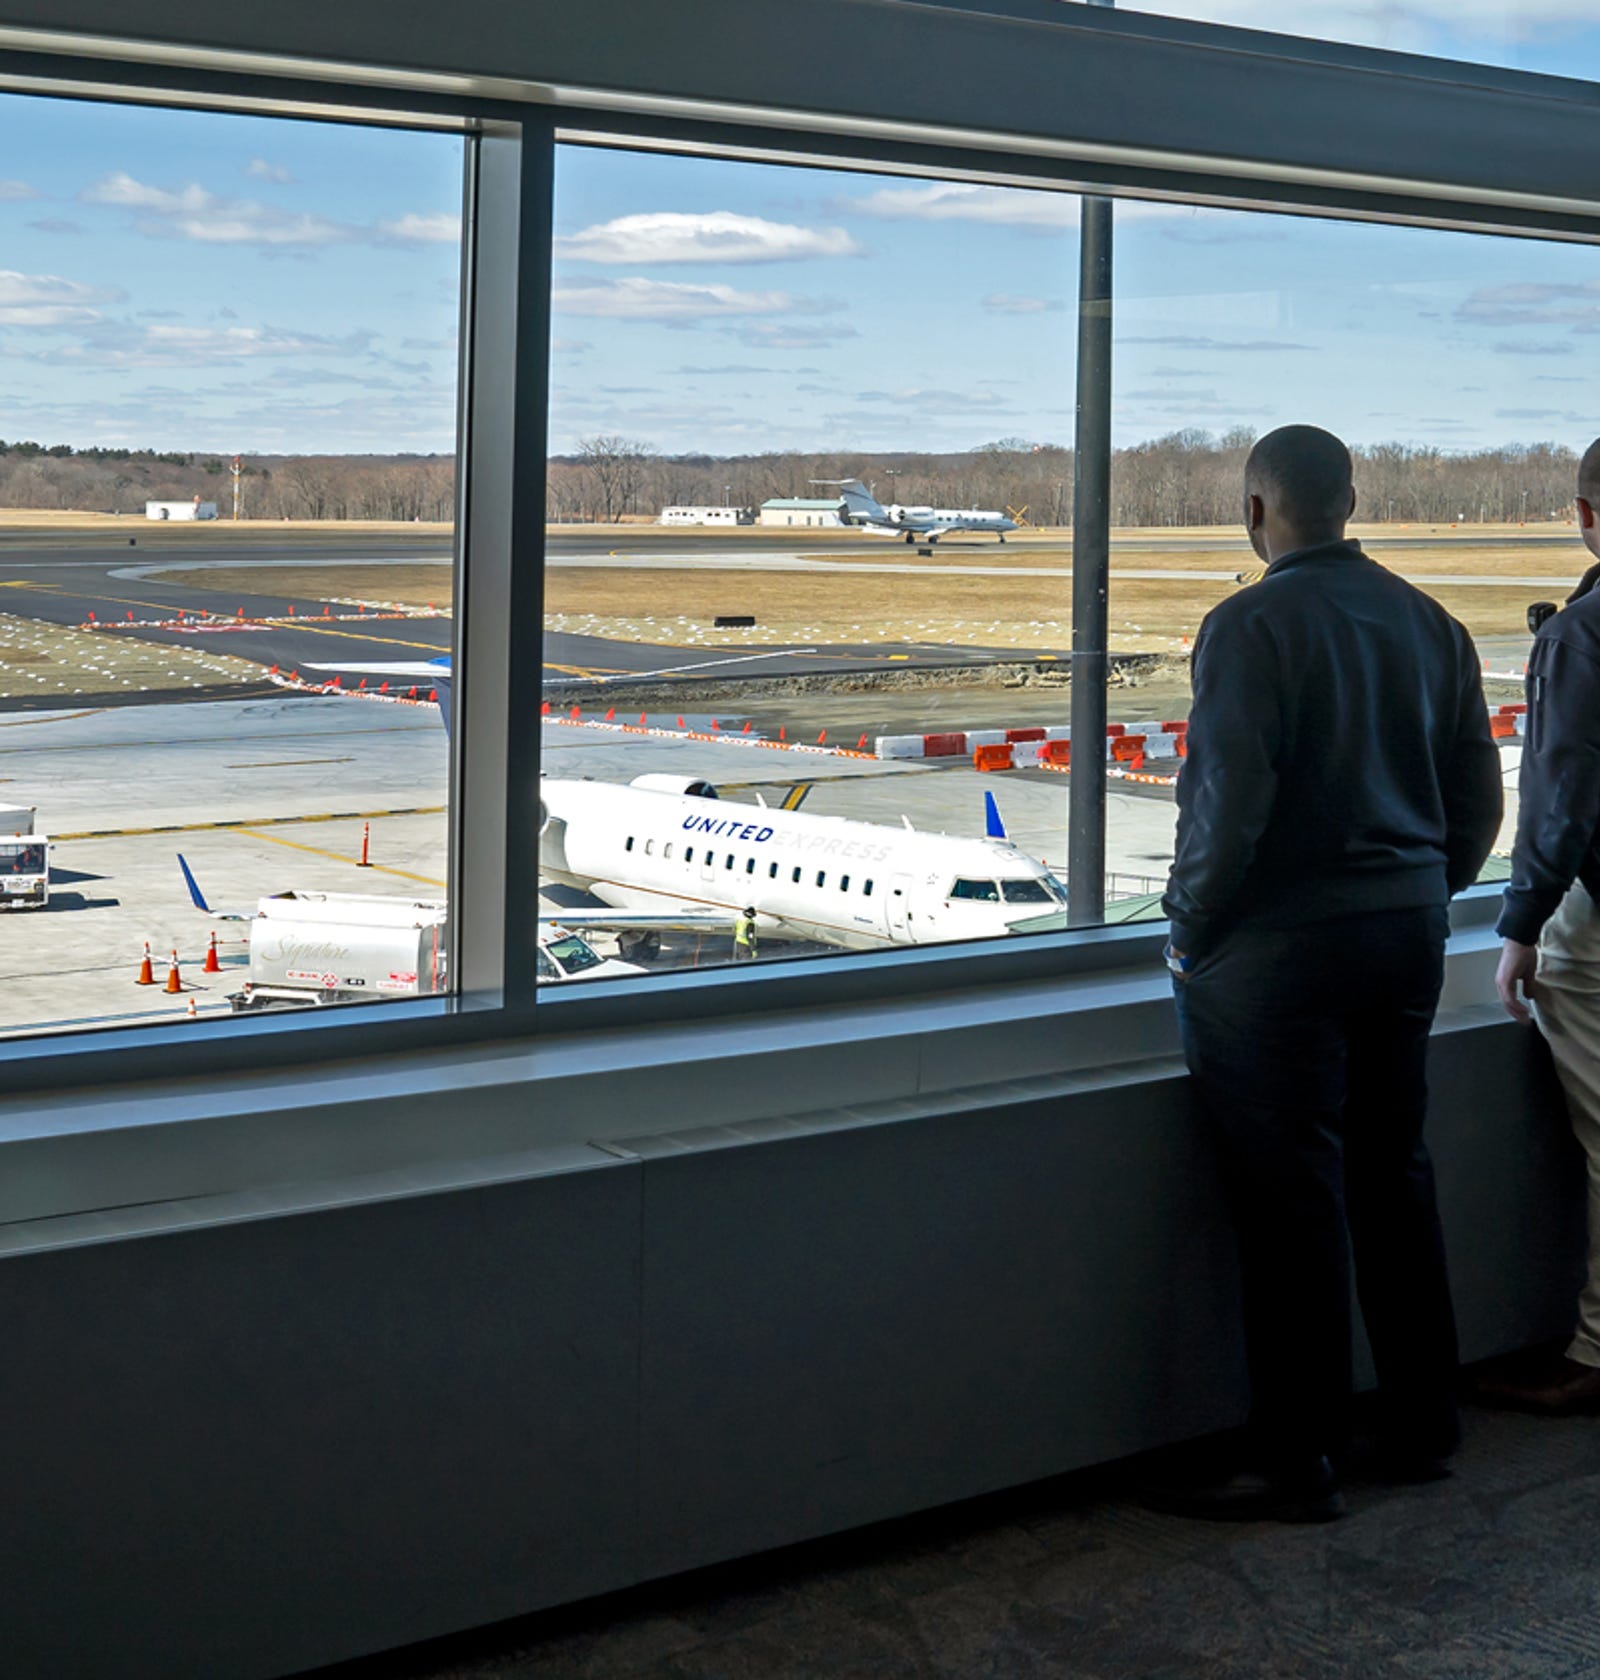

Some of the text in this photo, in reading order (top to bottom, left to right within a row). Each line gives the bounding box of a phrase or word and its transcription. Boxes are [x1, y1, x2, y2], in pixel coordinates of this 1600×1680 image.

[682, 815, 893, 862] UNITED EXPRESS
[261, 934, 349, 967] Signature
